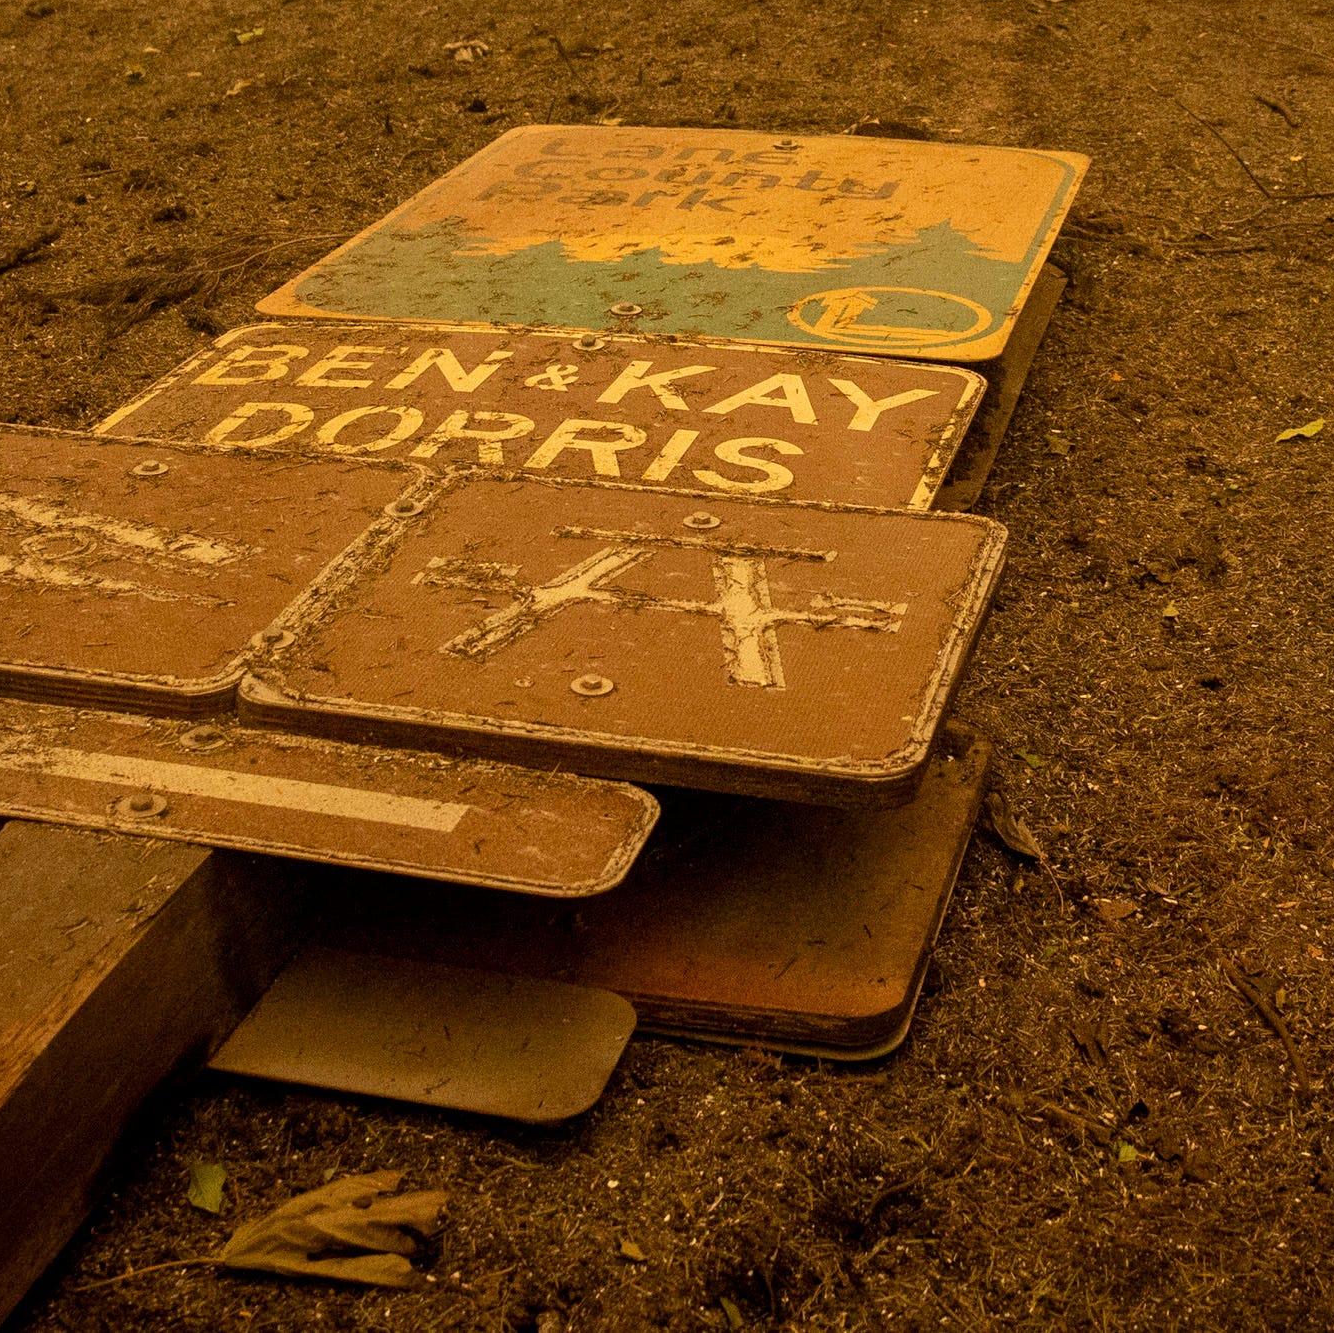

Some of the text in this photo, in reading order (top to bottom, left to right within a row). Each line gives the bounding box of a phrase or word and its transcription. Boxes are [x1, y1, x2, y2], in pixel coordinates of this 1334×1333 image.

[539, 137, 800, 167] Lane
[475, 180, 748, 214] Park
[513, 159, 904, 200] County
[190, 344, 940, 432] BEN & KAY
[204, 402, 804, 494] DORRIS
